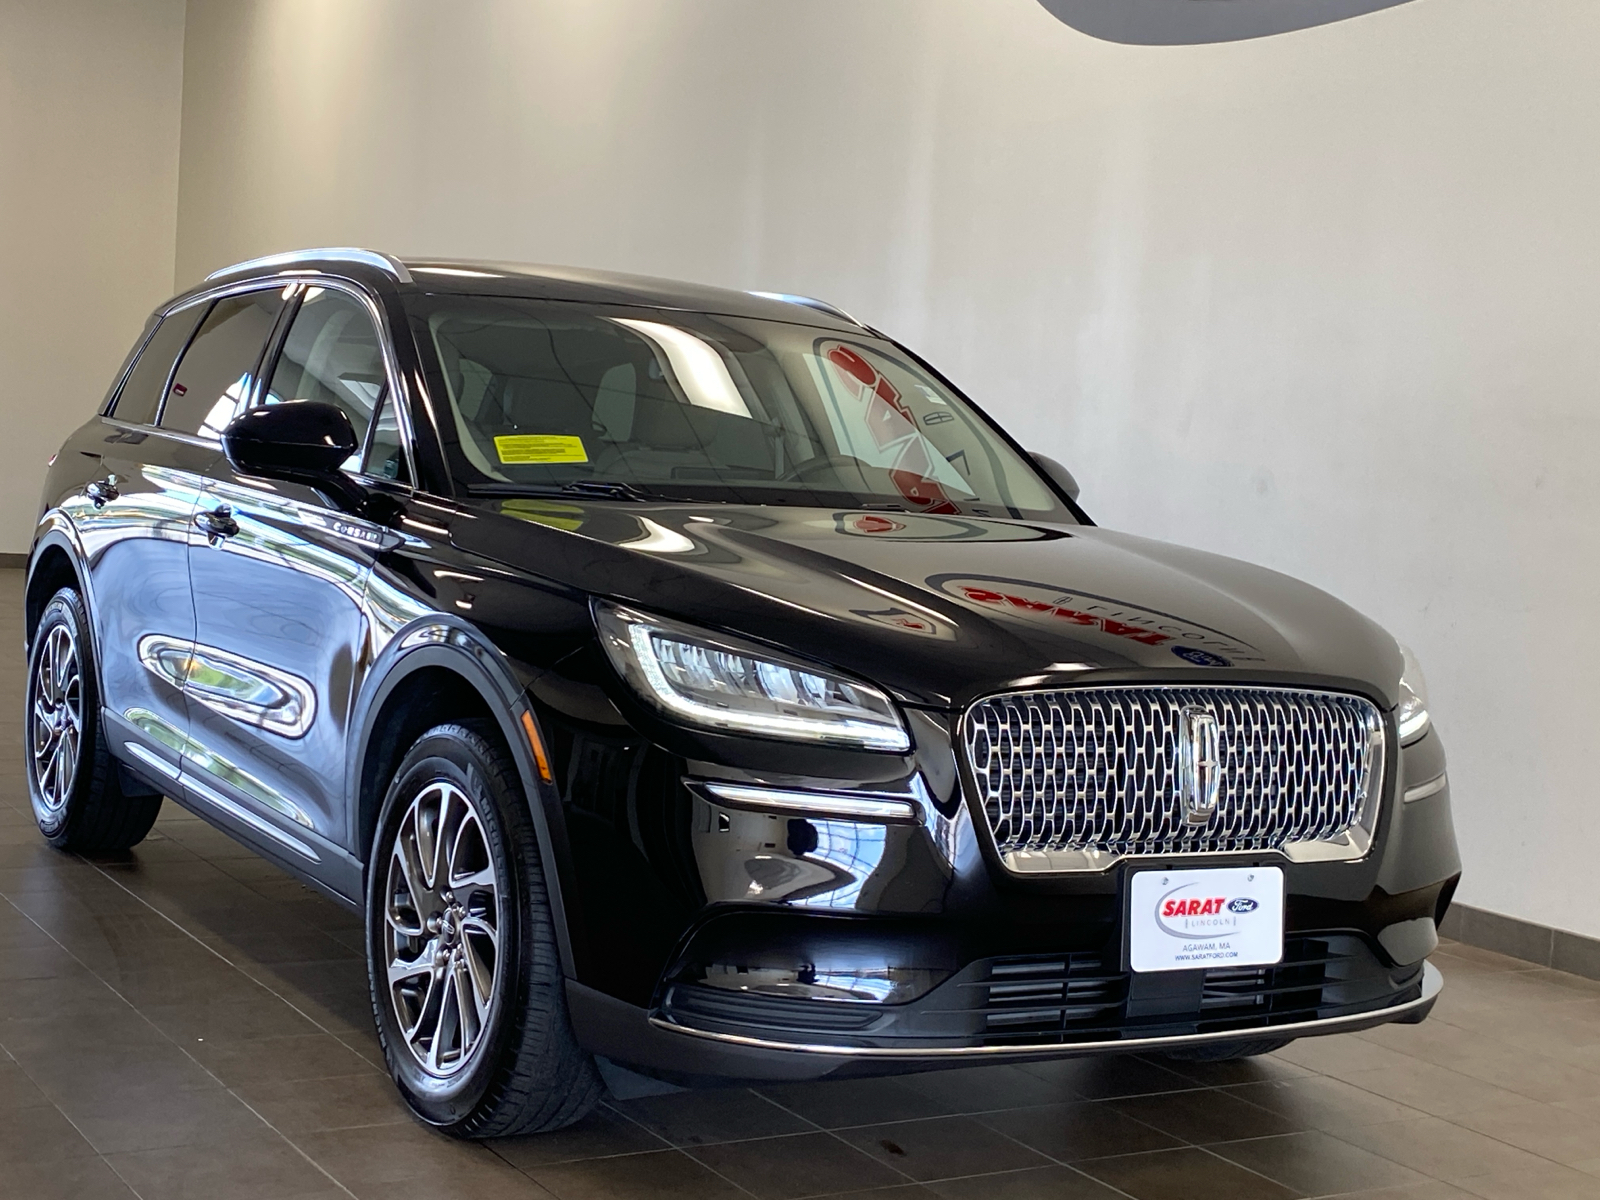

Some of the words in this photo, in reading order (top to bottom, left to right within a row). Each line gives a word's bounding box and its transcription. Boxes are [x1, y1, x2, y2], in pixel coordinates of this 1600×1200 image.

[333, 522, 378, 541] CORSAIR
[1162, 897, 1226, 917] SARAT
[1191, 918, 1230, 928] LINCOLN
[1182, 942, 1217, 952] AGAWAM,
[1219, 942, 1231, 950] MA
[1175, 951, 1239, 961] WWW.SARATFORD.COM
